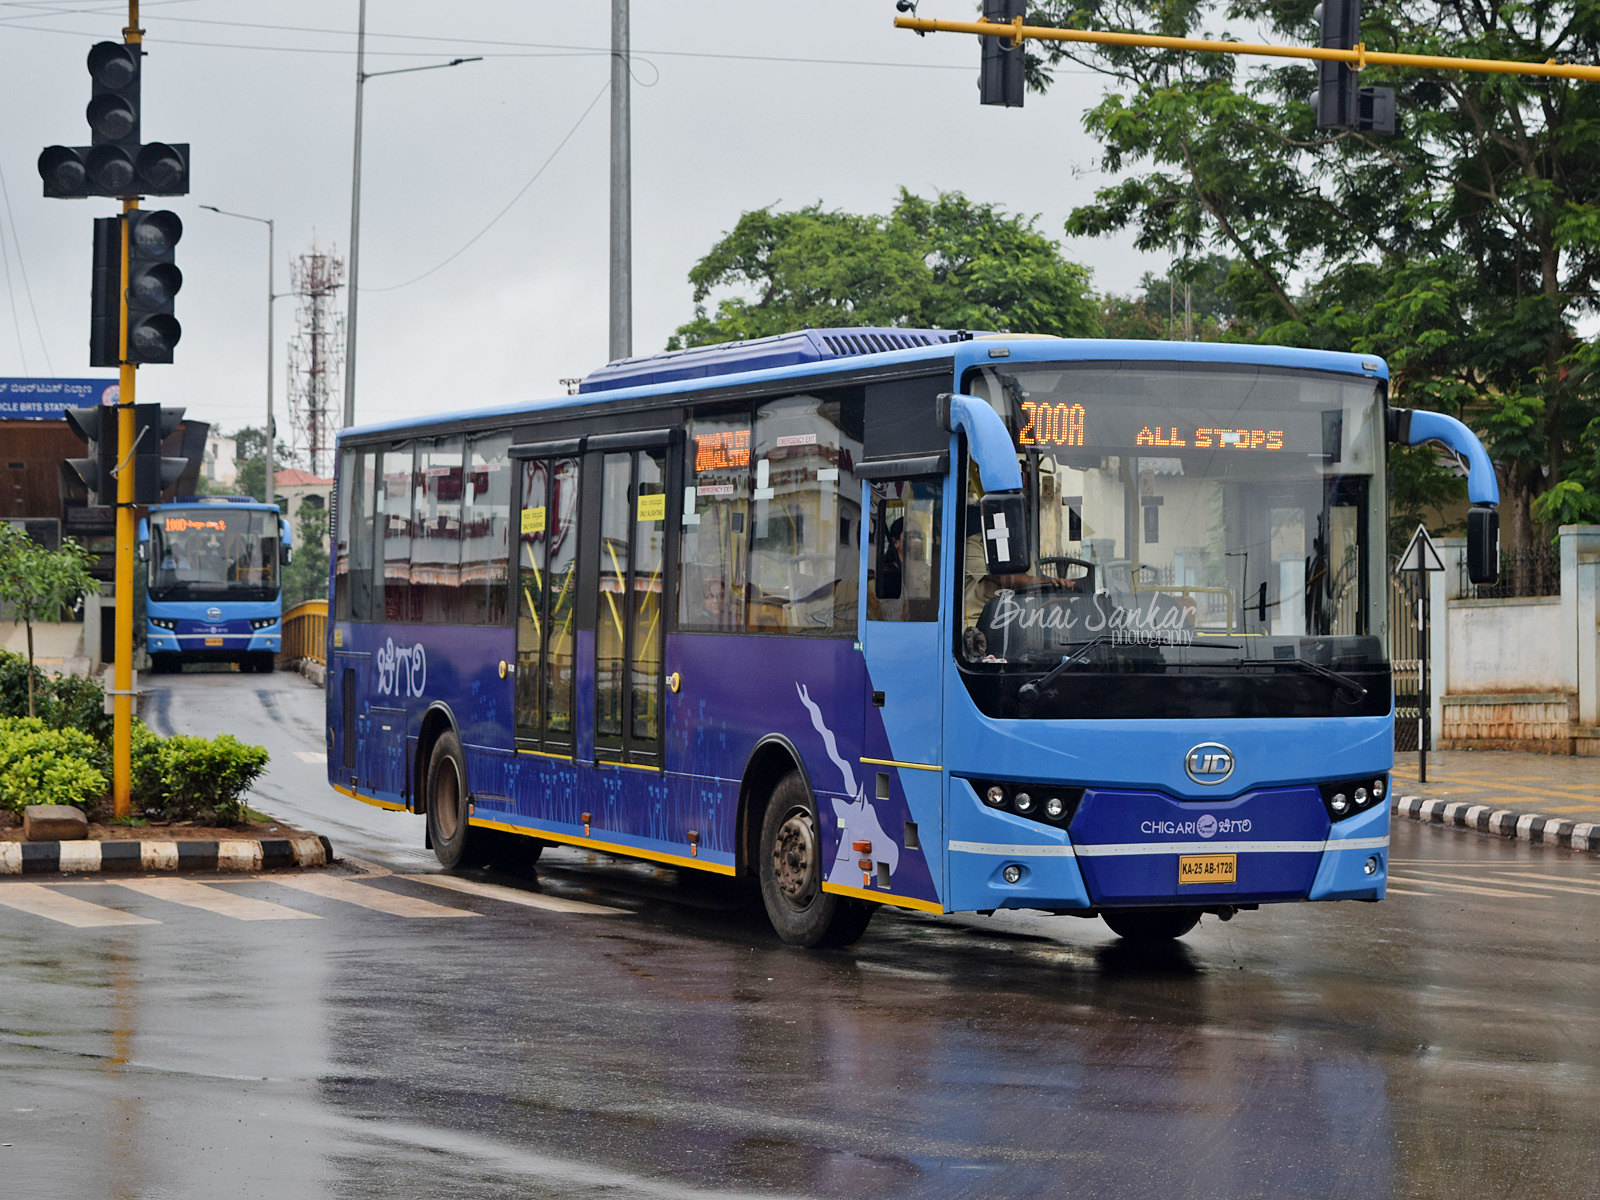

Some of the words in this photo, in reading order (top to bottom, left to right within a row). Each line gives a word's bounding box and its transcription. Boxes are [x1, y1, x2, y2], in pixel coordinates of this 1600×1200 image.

[20, 402, 43, 412] BRTS
[1019, 401, 1086, 446] 200A
[1136, 425, 1186, 447] ALL
[1195, 427, 1284, 450] STOPS
[778, 436, 805, 447] EMERGENCY
[805, 433, 817, 444] EXIT
[697, 486, 723, 496] EMERGENCY
[723, 485, 734, 494] EXIT
[1140, 821, 1196, 834] CHIGARI
[1182, 862, 1203, 874] KA-25
[1204, 862, 1233, 874] AB-1728
